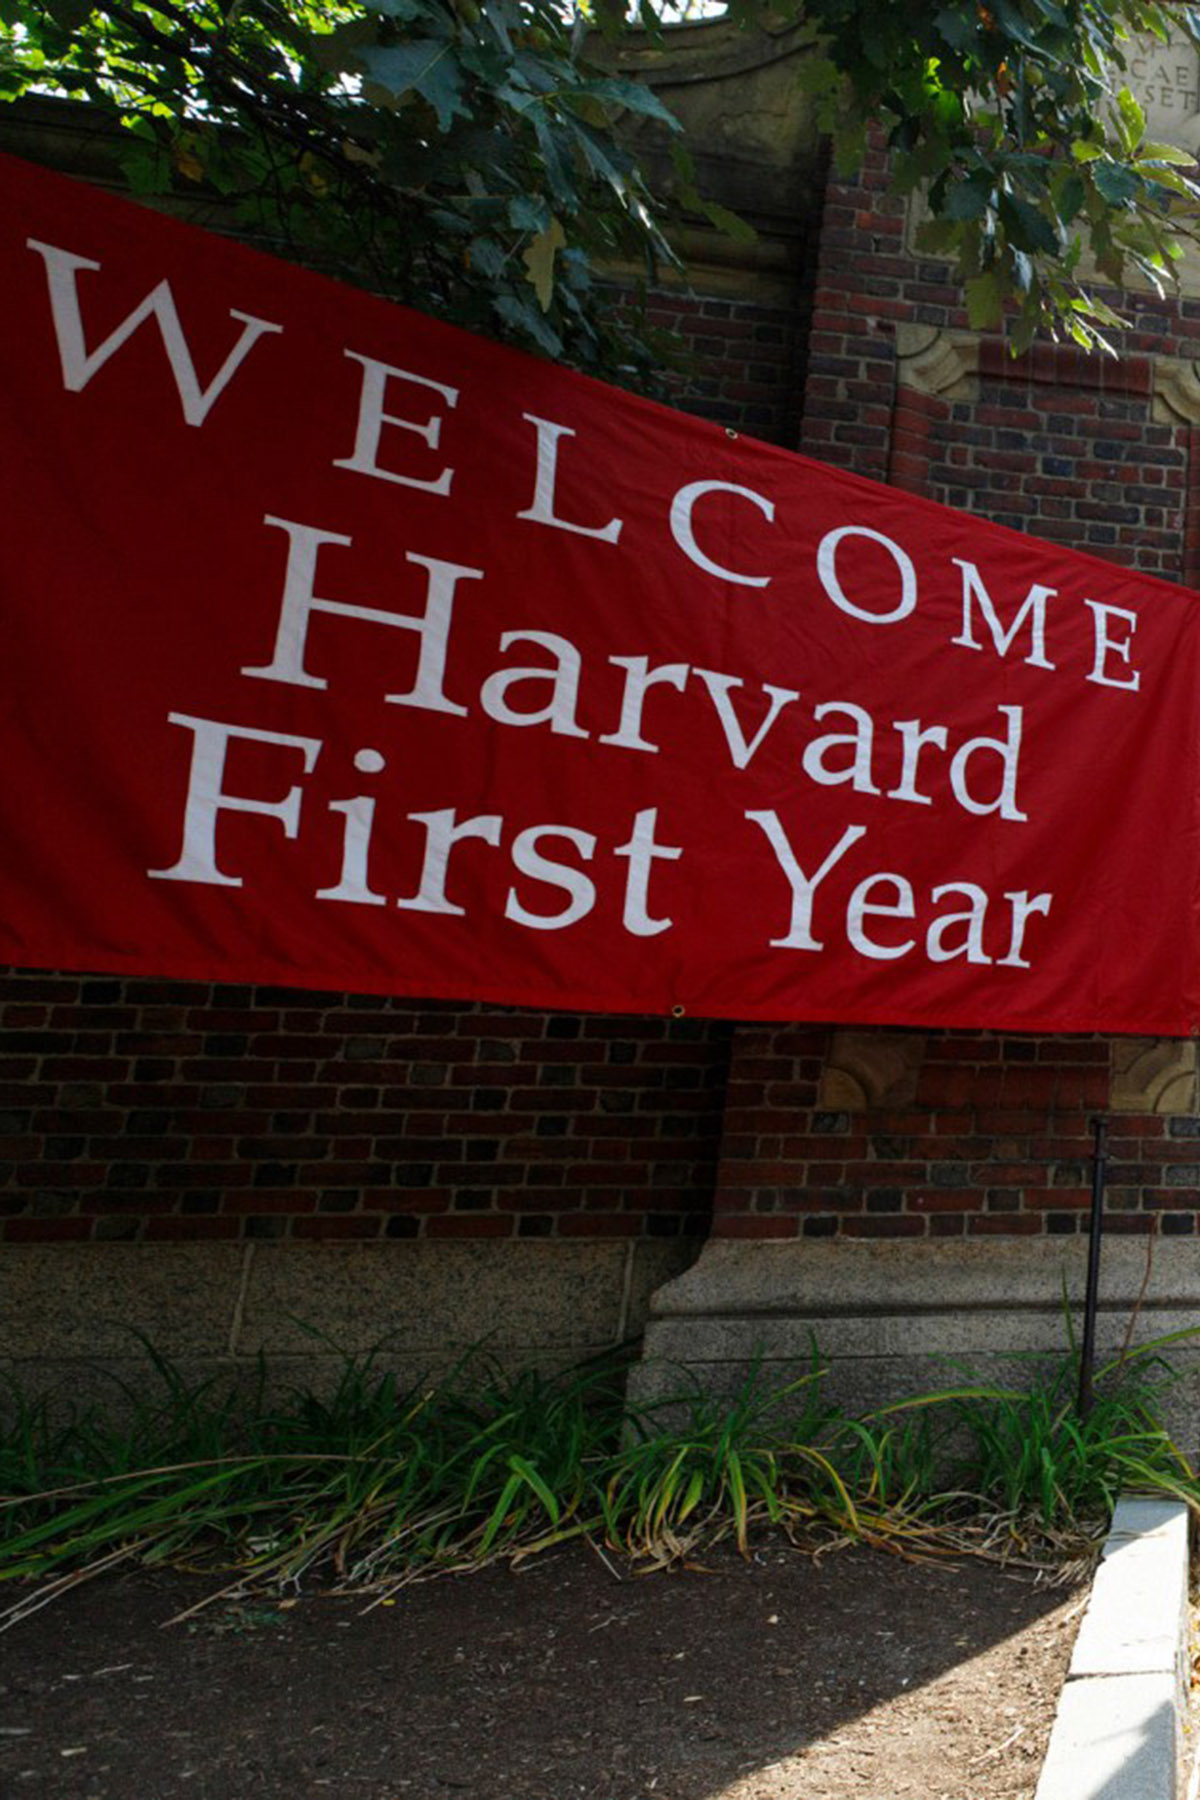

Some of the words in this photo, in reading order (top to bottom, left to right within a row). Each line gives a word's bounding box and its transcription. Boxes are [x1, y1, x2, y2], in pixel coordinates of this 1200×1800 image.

[25, 237, 1142, 693] WELCOME
[240, 514, 1029, 823] Harvard
[147, 711, 684, 937] First
[744, 809, 1053, 969] Year
